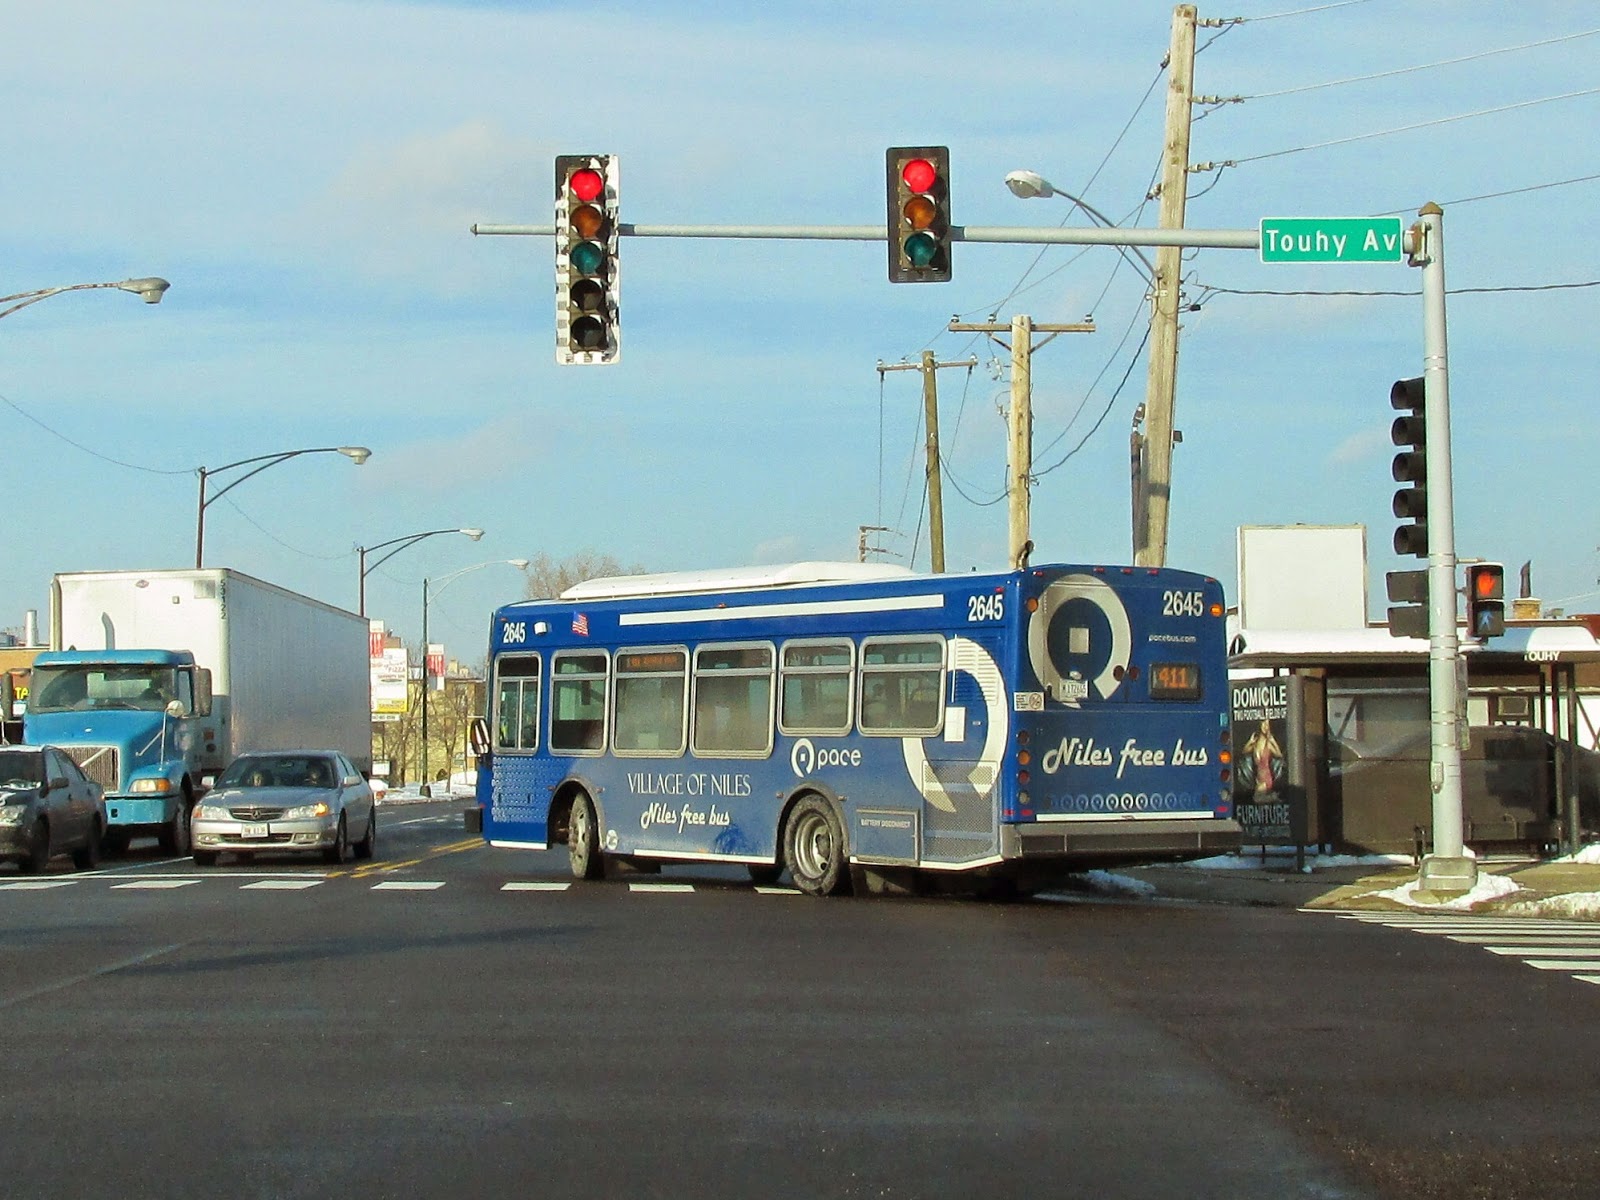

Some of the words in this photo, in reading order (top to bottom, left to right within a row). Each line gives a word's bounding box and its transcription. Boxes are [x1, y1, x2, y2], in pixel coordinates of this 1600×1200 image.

[1265, 229, 1347, 257] Touhy
[1363, 229, 1397, 251] Av
[968, 594, 1004, 622] 2645
[1163, 590, 1204, 617] 2645
[503, 622, 526, 643] 2645
[1148, 634, 1197, 643] pacebus.com
[1158, 667, 1188, 689] 411
[1233, 685, 1287, 708] DOMICILE
[817, 749, 862, 769] pace
[1042, 737, 1112, 774] Niles
[1116, 738, 1165, 779] free
[1171, 738, 1208, 766] bus
[627, 772, 683, 795] VILLAGE
[686, 773, 706, 796] OF
[711, 774, 751, 797] NILES
[640, 802, 677, 829] Niles
[678, 803, 705, 833] free
[709, 804, 730, 826] bus
[1236, 804, 1290, 825] FURNITURE
